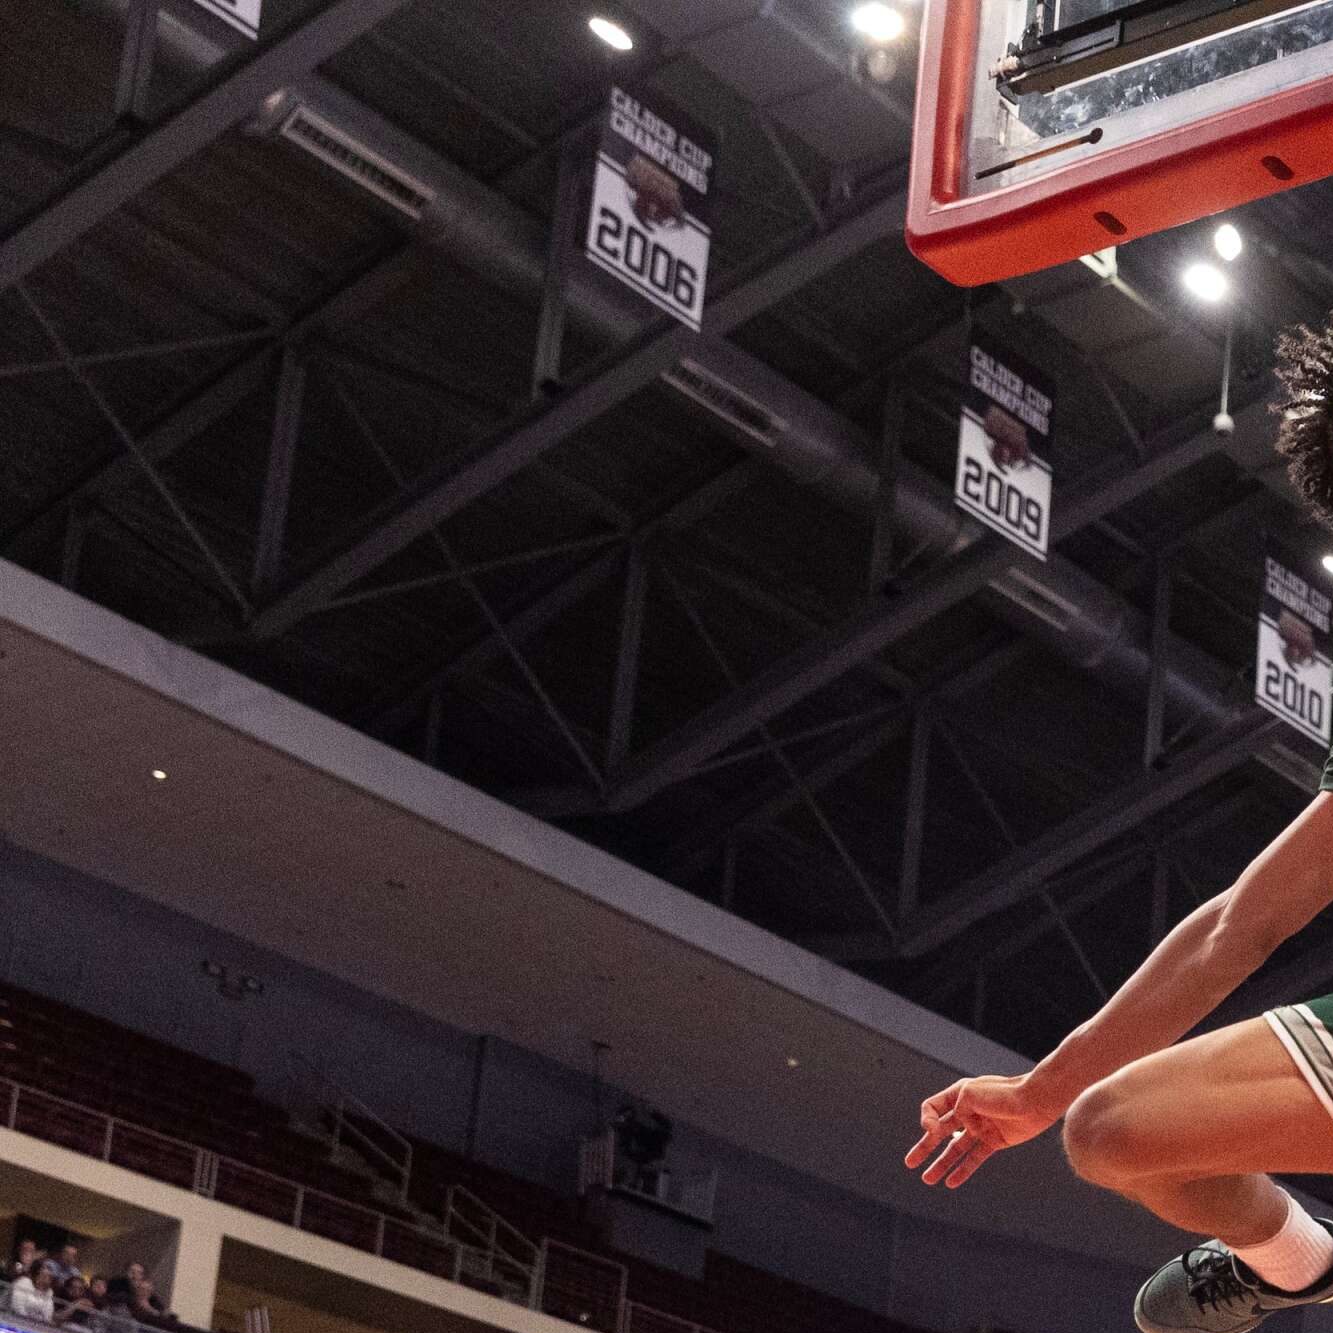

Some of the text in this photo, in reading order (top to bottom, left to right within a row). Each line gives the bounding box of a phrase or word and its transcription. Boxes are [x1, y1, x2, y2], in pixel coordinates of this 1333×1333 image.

[596, 207, 697, 310] 2006
[962, 457, 1042, 542] 2009
[1264, 660, 1323, 730] 2010
